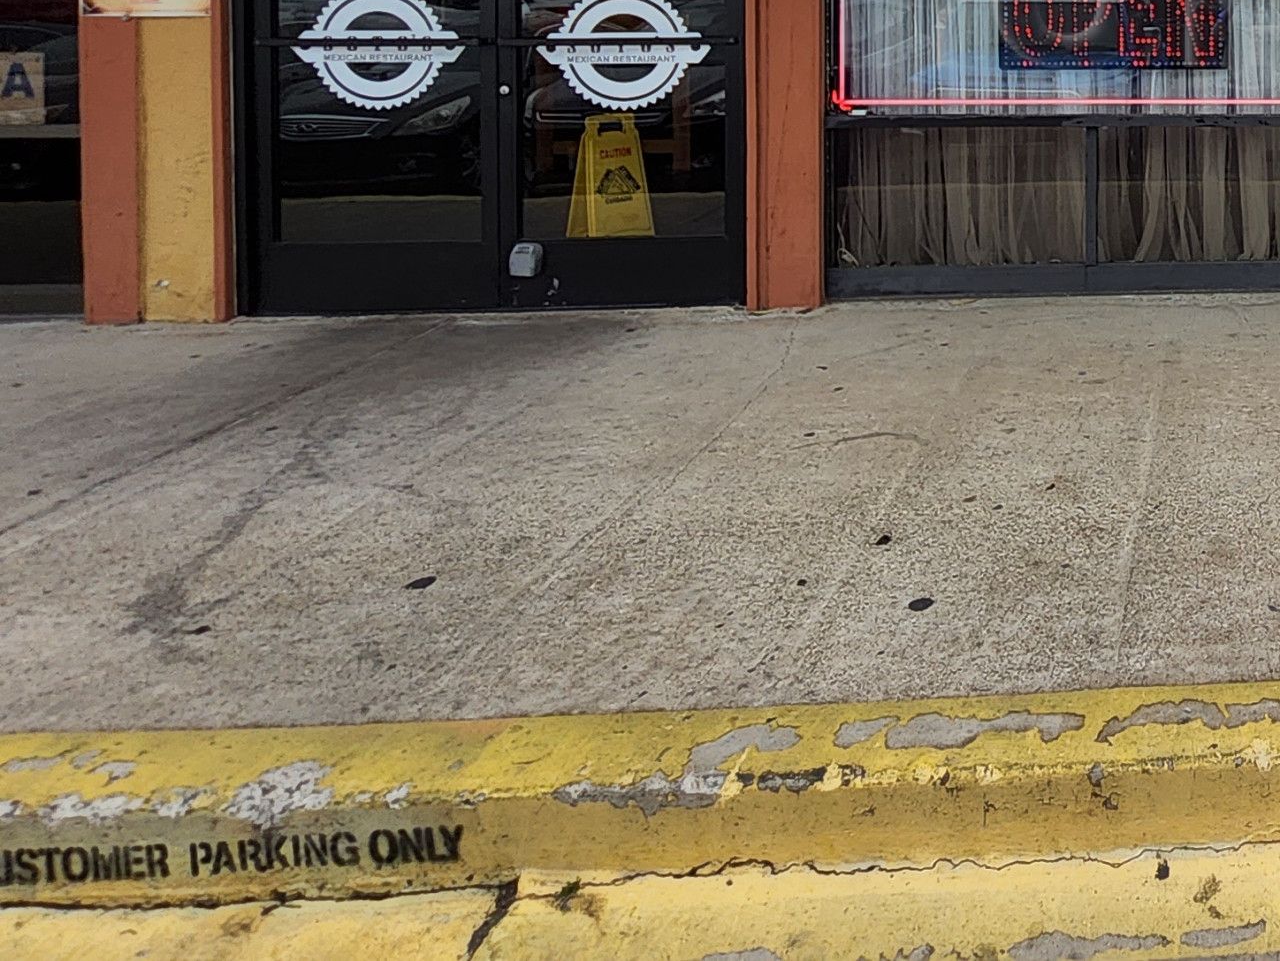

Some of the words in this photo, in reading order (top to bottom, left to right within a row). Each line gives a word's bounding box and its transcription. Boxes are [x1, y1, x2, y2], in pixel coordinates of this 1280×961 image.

[323, 54, 367, 62] MEXICAN
[369, 54, 434, 62] RESTAURANT
[566, 55, 611, 63] MEXICAN
[613, 54, 677, 63] RESTAURANT
[1, 62, 36, 98] A
[600, 147, 632, 159] CAUTION
[189, 830, 360, 878] PARKING
[368, 824, 465, 868] ONLY
